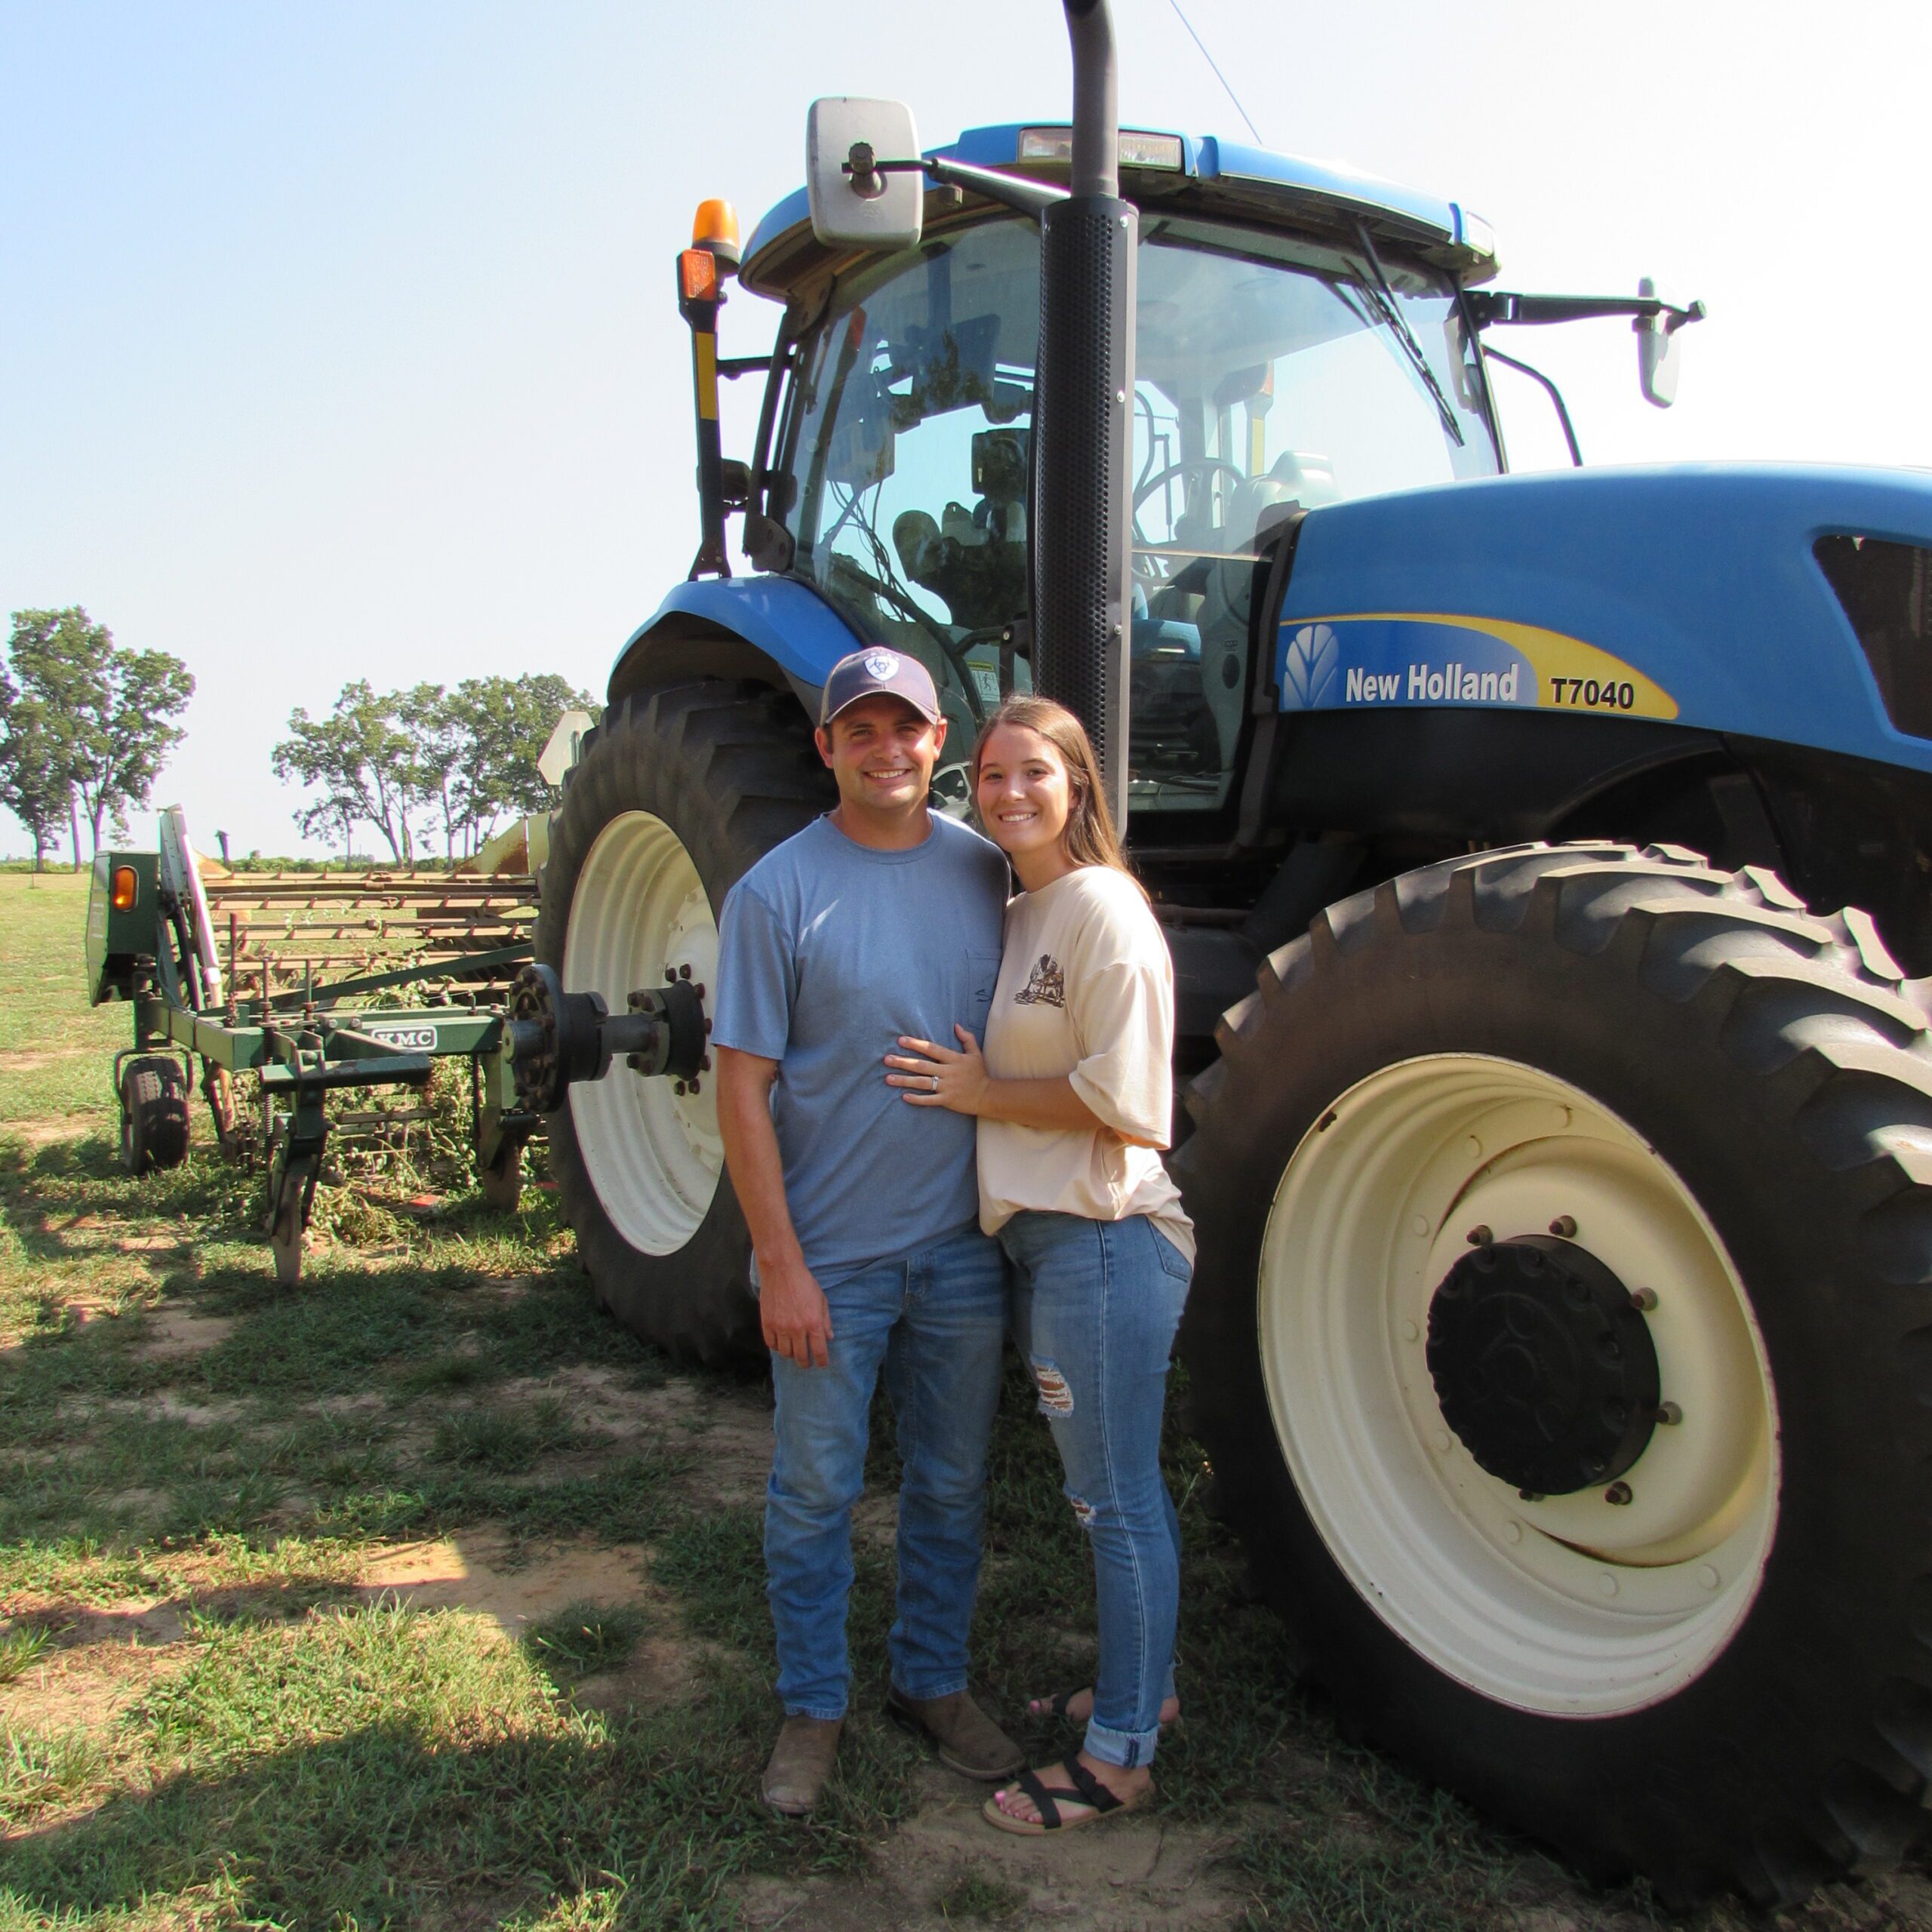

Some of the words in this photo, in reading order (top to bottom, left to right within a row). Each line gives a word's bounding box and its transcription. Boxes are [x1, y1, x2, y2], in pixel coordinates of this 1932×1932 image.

[1346, 667, 1400, 703] New
[1407, 663, 1518, 702] Holland
[1549, 677, 1634, 709] T7040
[377, 1031, 432, 1046] KMC
